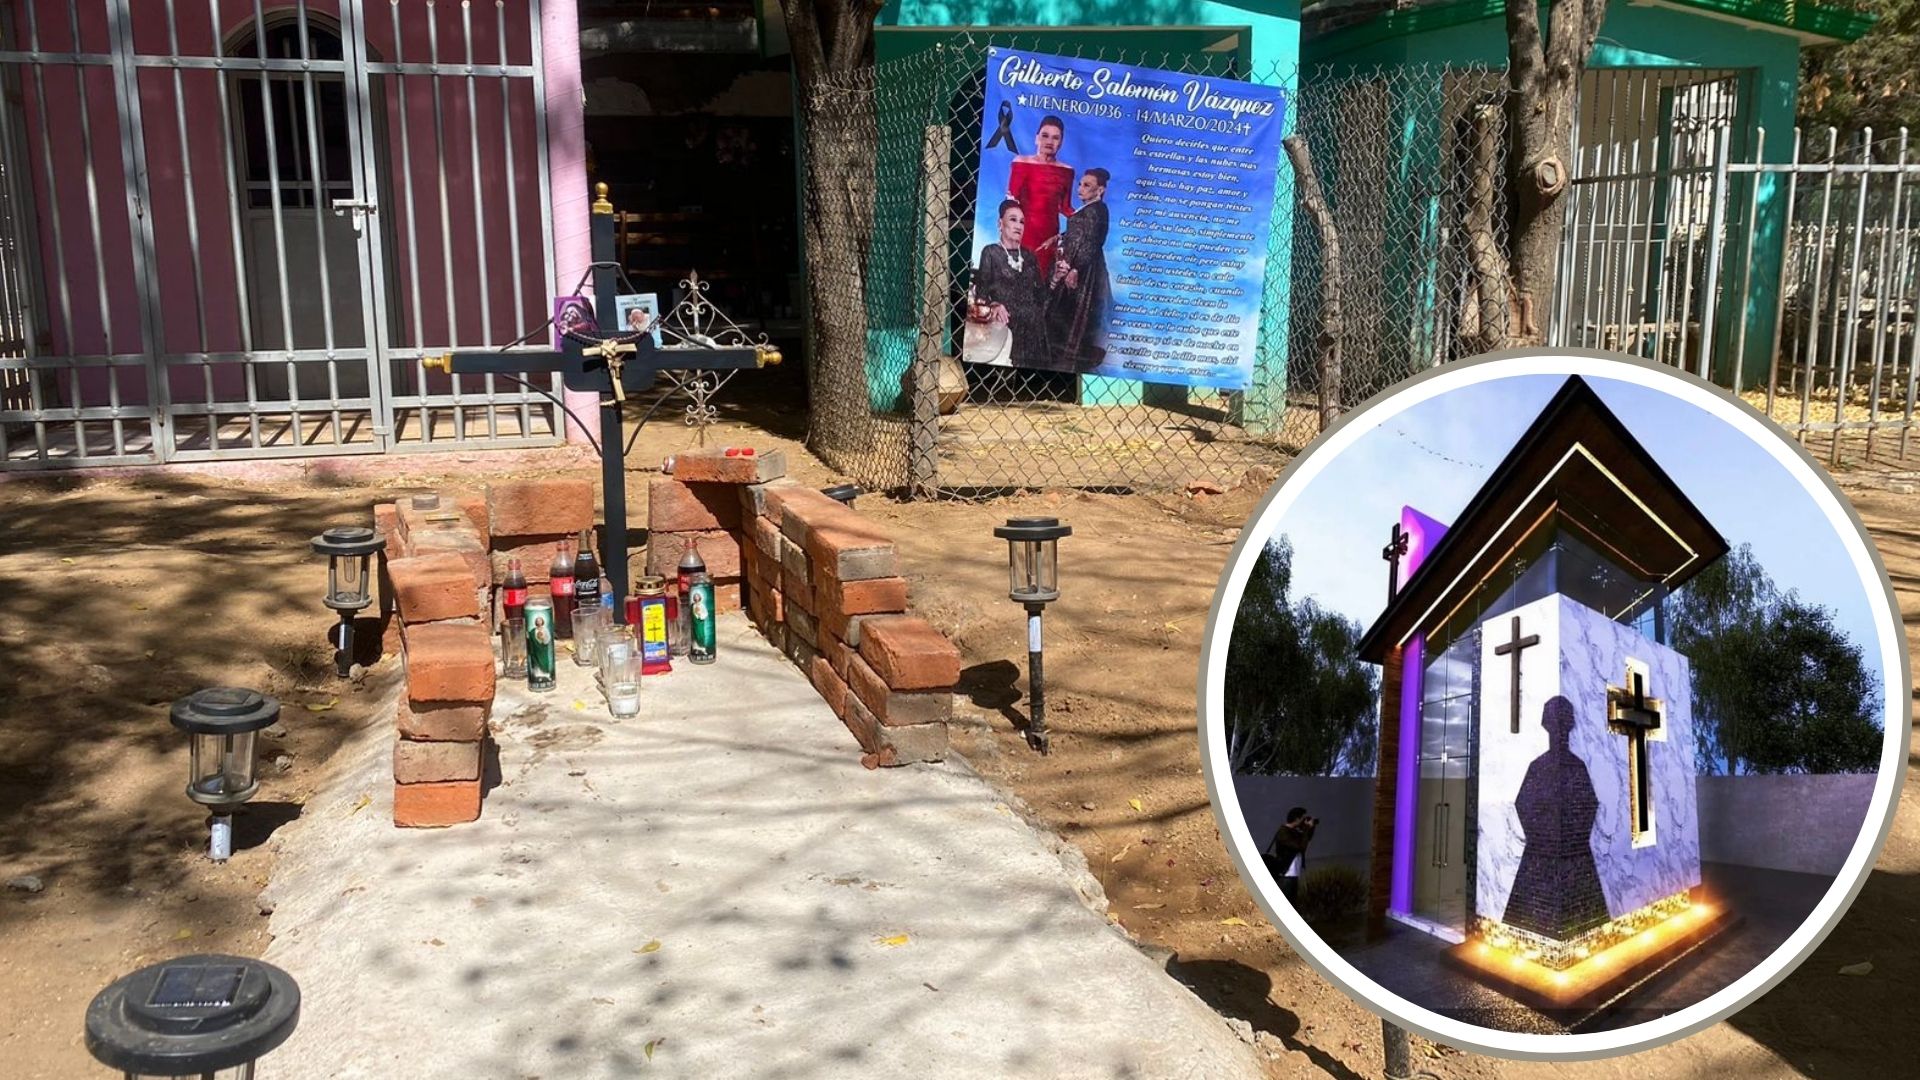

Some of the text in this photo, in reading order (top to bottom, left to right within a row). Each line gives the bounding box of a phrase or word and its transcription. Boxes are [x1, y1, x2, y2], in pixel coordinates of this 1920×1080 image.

[998, 55, 1275, 119] Gilberto Salomón Vázquez
[1141, 133, 1254, 156] Quiero decirles que entre
[1133, 147, 1257, 170] las estrellas y las nubes mas
[1147, 163, 1190, 176] hermosas
[1192, 170, 1216, 181] estoy
[1158, 181, 1177, 190] solo
[1178, 181, 1195, 193] hay
[1217, 187, 1242, 197] amor
[1242, 190, 1249, 199] y
[1164, 196, 1177, 204] no
[1188, 199, 1224, 209] pongan
[1225, 202, 1253, 212] tristes
[1135, 207, 1152, 217] por
[1153, 209, 1167, 218] mi
[1212, 216, 1225, 224] no
[1226, 217, 1240, 225] me
[1119, 218, 1131, 227] he
[1133, 219, 1147, 229] ido
[1149, 221, 1160, 230] de
[1162, 224, 1173, 232] su
[1199, 228, 1256, 241] simplemente
[1121, 234, 1249, 255] que ahora no me pueden ver
[1134, 249, 1149, 258] me
[1149, 250, 1183, 262] pueden
[1220, 259, 1246, 271] estoy
[1147, 265, 1163, 273] con
[1164, 267, 1197, 279] ustedes
[1199, 271, 1211, 279] en
[1129, 291, 1144, 300] me
[1144, 277, 1156, 287] de
[1209, 285, 1245, 297] cuando
[1113, 303, 1148, 315] mirada
[1211, 312, 1224, 322] de
[1112, 317, 1127, 327] me
[1177, 324, 1201, 335] nube
[1201, 327, 1220, 337] que
[1118, 346, 1152, 358] estrella
[1152, 349, 1171, 360] que
[1183, 337, 1196, 348] de
[1195, 339, 1226, 351] noche
[1226, 343, 1240, 352] en
